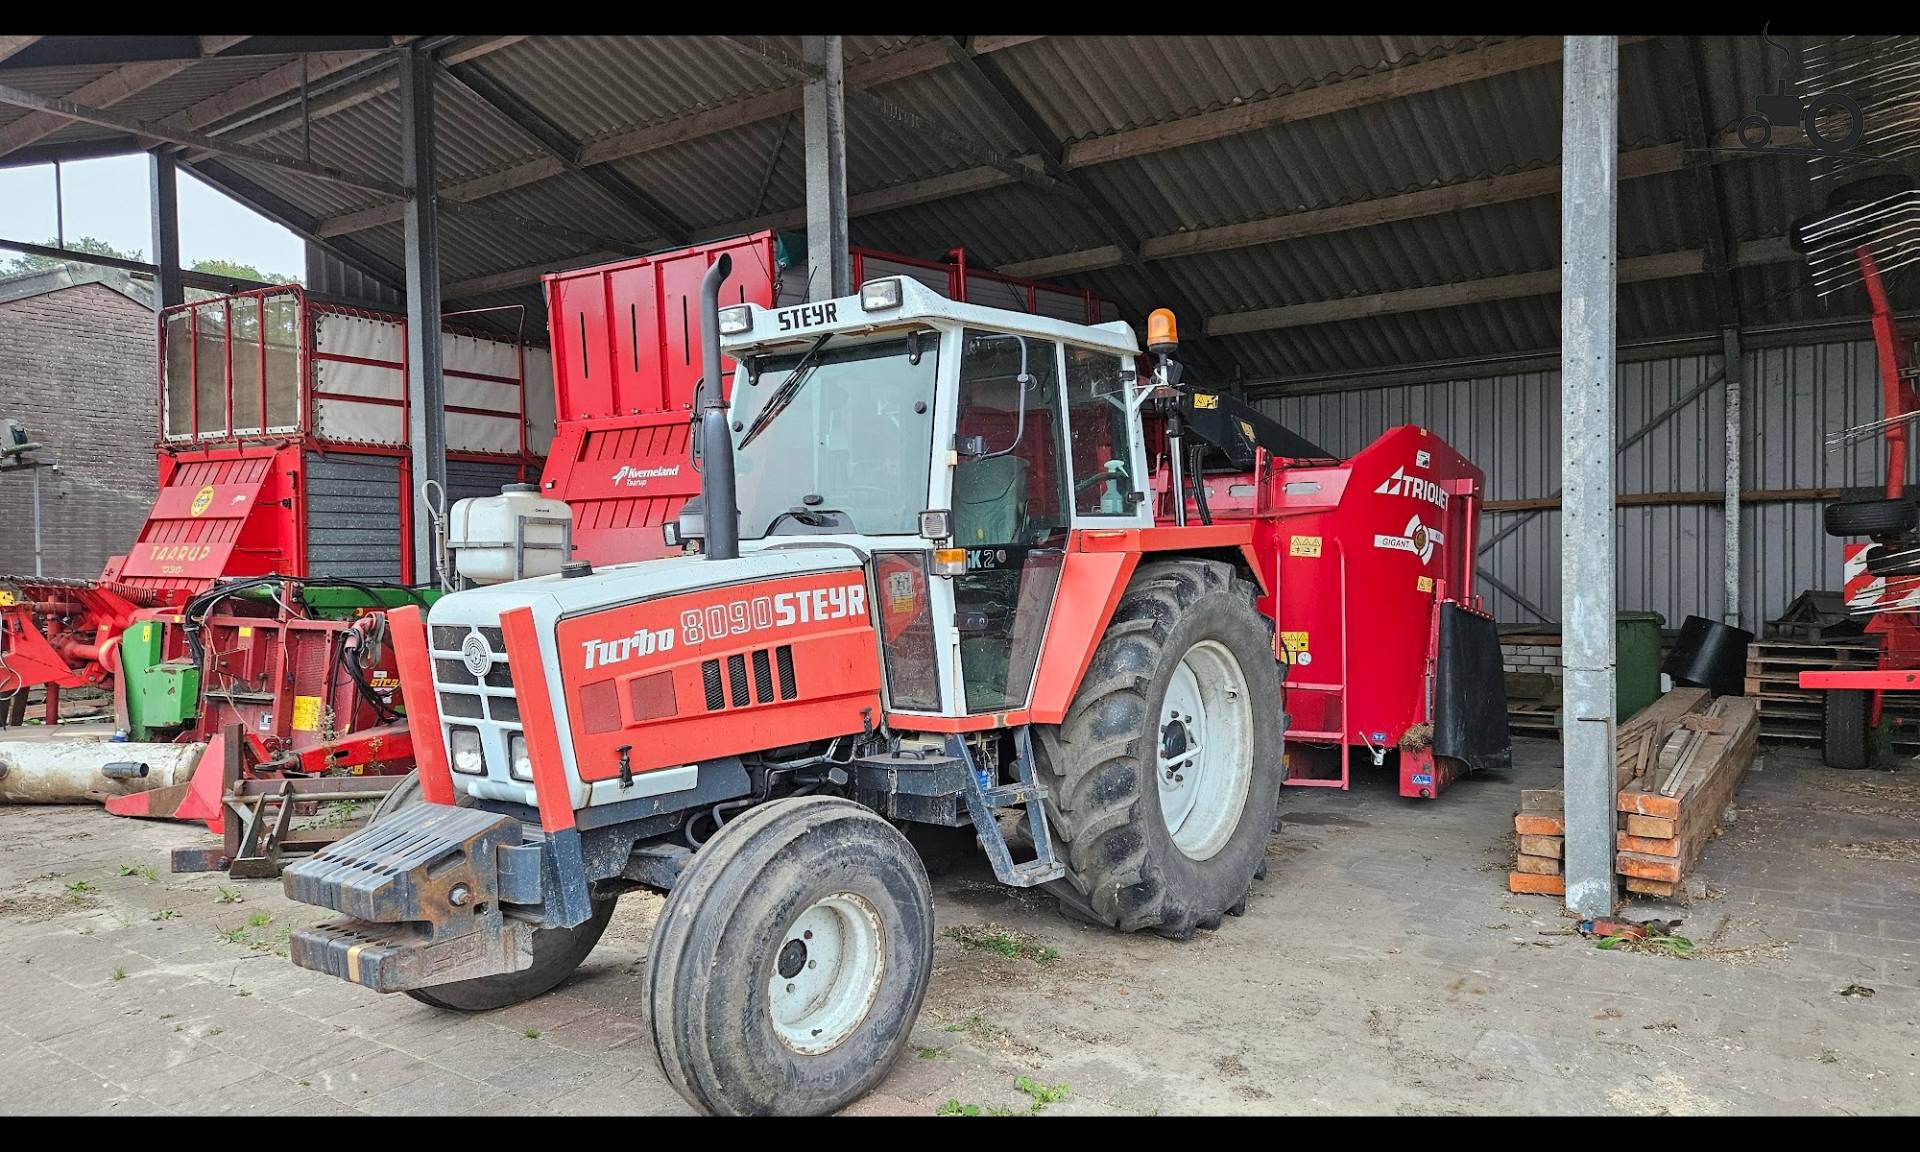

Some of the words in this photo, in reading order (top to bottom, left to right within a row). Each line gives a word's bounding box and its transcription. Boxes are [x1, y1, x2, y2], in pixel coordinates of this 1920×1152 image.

[778, 302, 838, 331] STEYR
[628, 464, 680, 479] Kverneland
[1402, 474, 1449, 512] TRIOLIET
[150, 545, 211, 561] TAARUP
[581, 627, 675, 670] Turbo
[680, 596, 773, 646] 8090
[774, 584, 866, 627] STEYR
